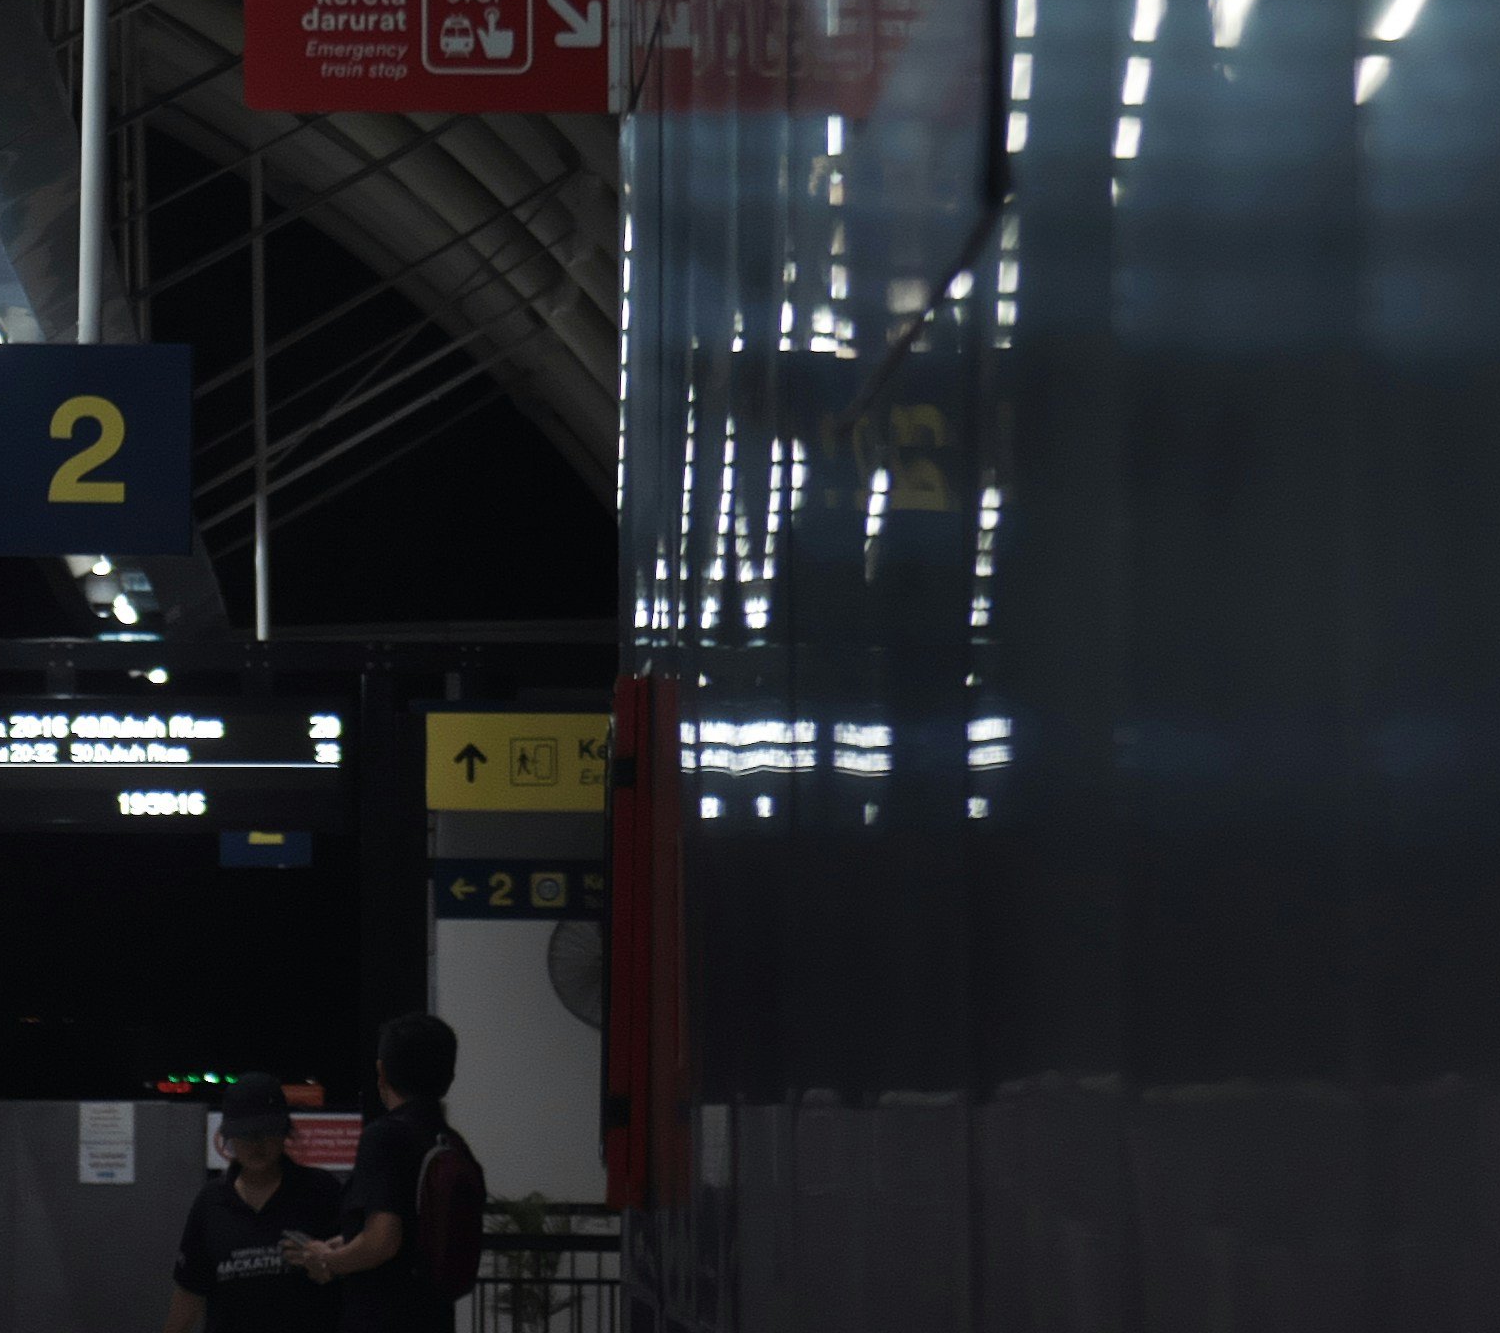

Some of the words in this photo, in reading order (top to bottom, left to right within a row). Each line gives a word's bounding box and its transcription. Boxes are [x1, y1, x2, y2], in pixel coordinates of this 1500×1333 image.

[301, 7, 407, 32] darurat
[305, 40, 408, 61] Emergency
[321, 61, 363, 78] train
[368, 62, 408, 81] stop
[48, 395, 125, 503] 2
[488, 871, 515, 906] 2
